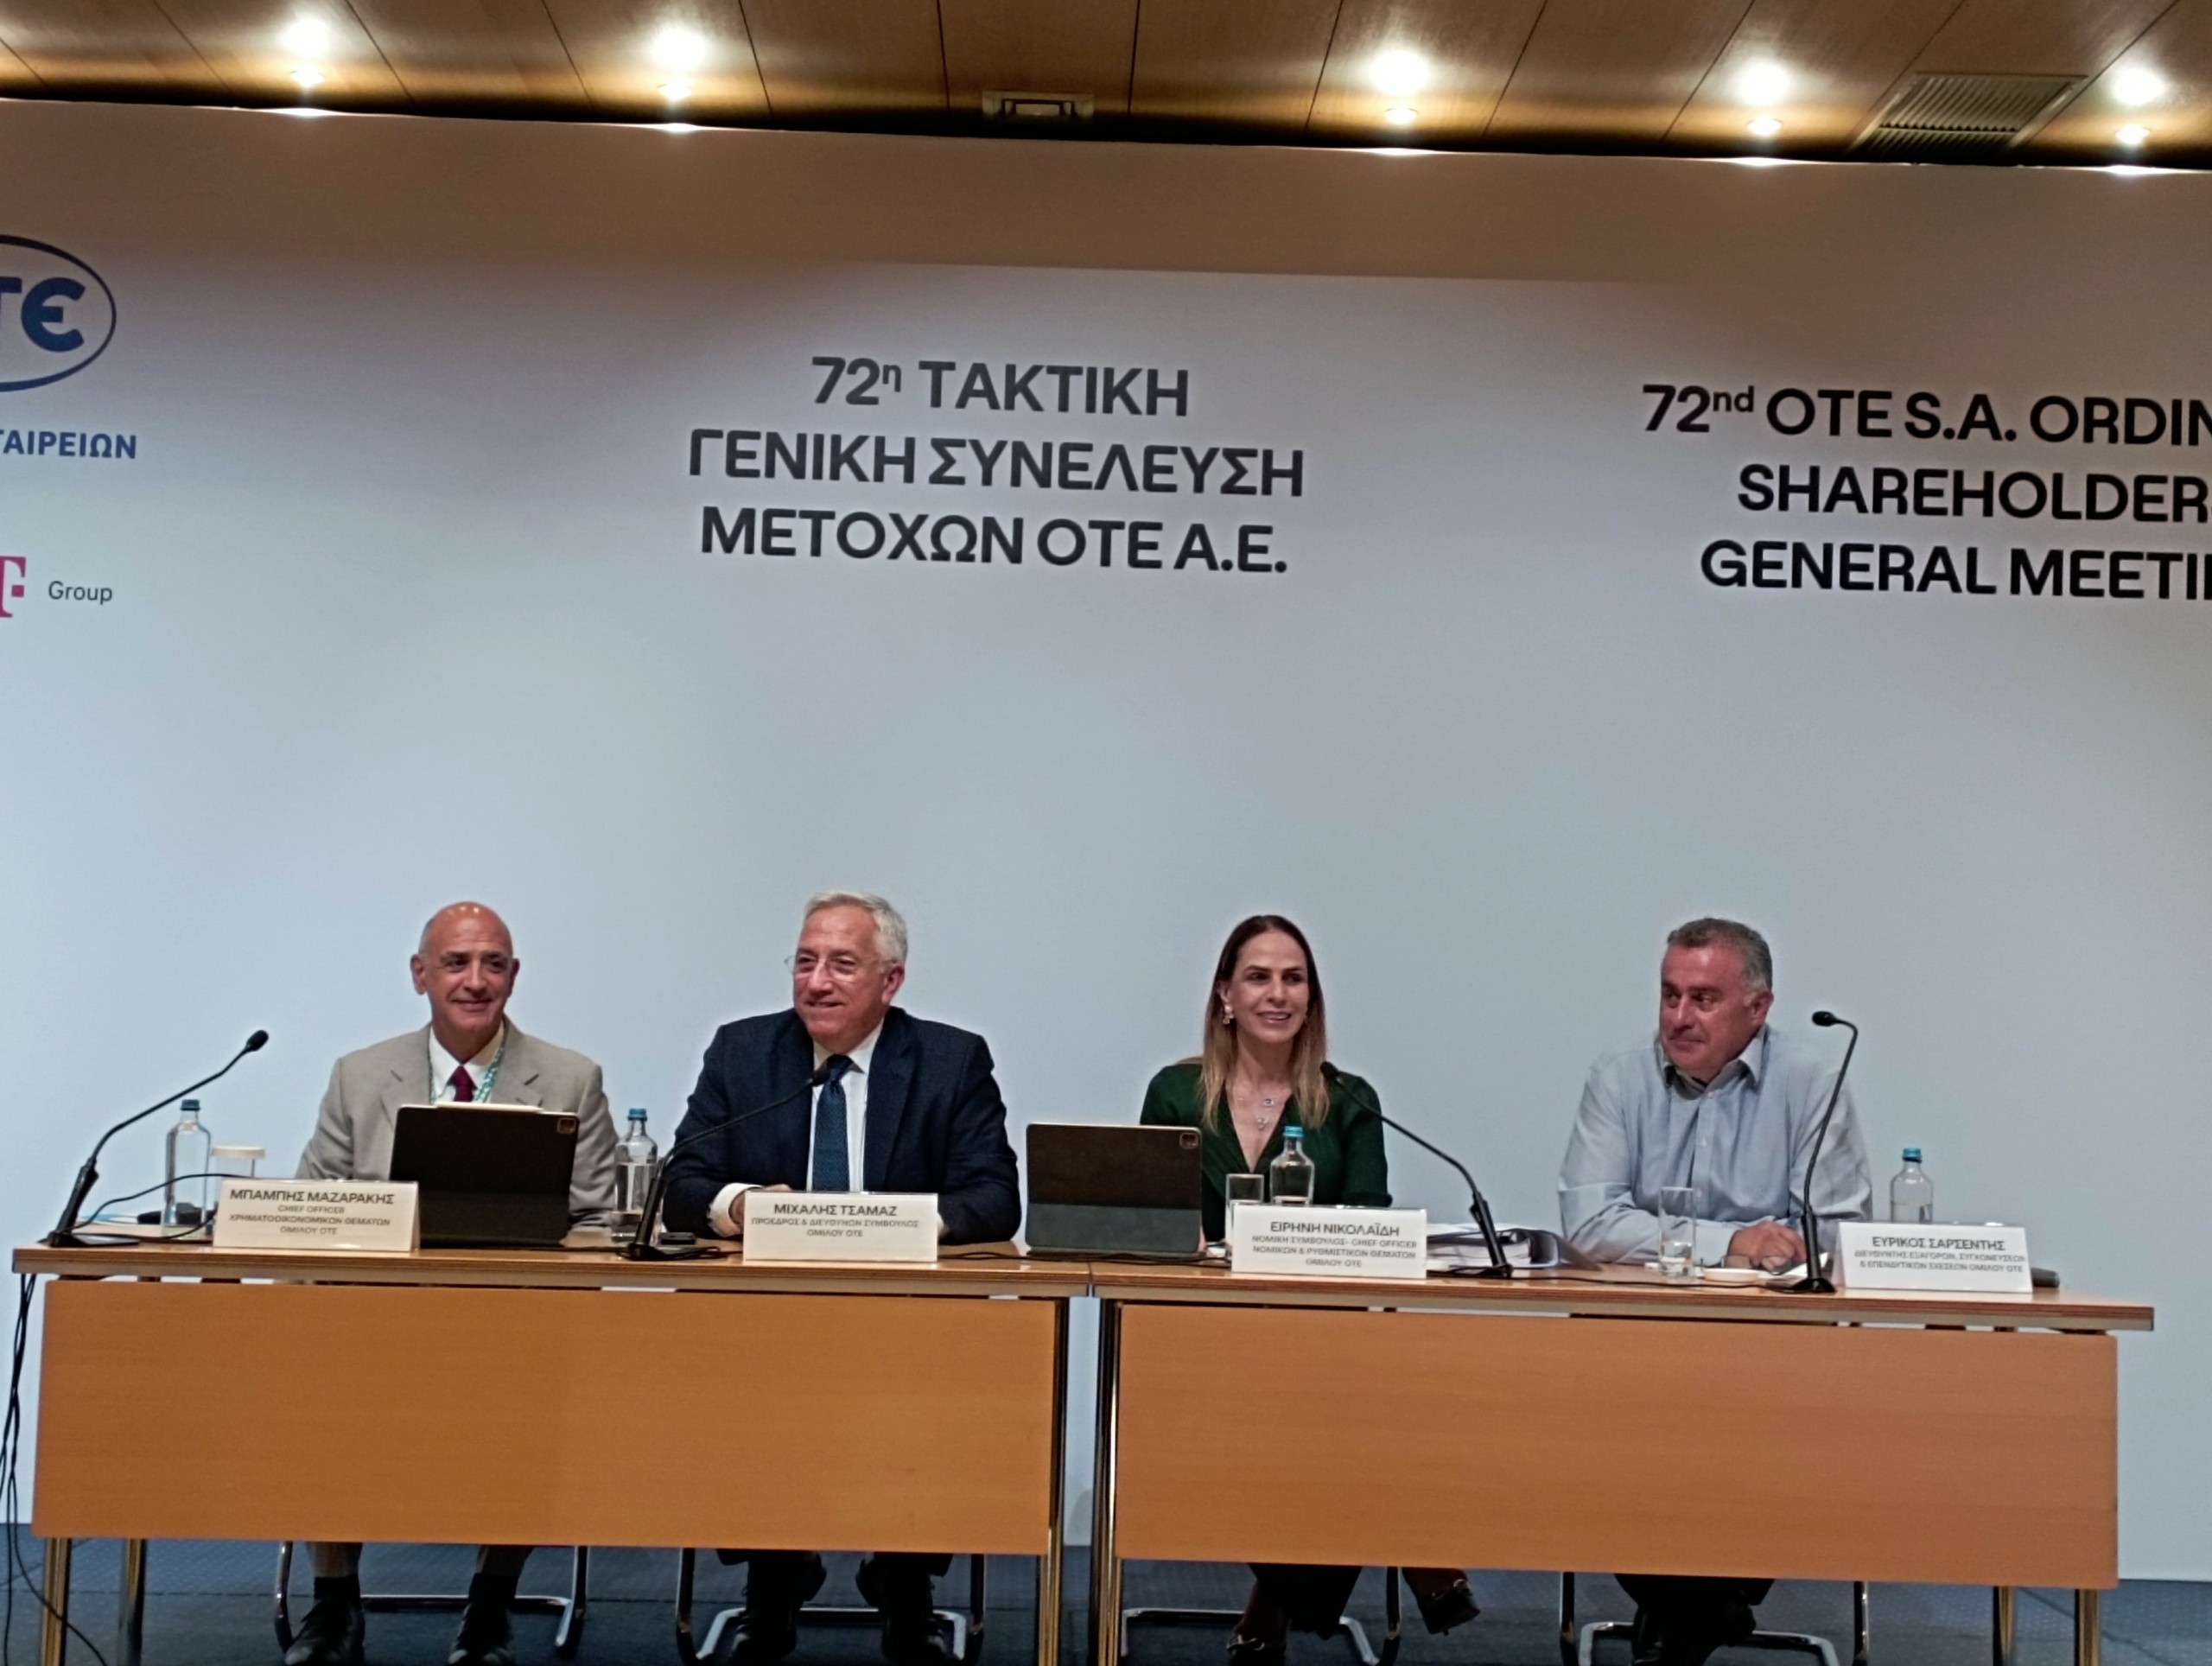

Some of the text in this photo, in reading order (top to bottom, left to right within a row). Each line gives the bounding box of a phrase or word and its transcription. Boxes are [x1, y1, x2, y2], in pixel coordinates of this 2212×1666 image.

[918, 359, 1189, 416] ΤΑΚΤΙΚΗ
[1643, 385, 1755, 433] 72nd
[1766, 388, 1892, 437] OTE
[1904, 392, 2017, 441] S.A.
[690, 429, 1304, 498] ΓΕΝΙΚΗ ΣΥΝΕΛΕΥΣΗ
[1738, 464, 2212, 523] SHAREHOLDER
[701, 506, 1287, 573] ΜΕΤΟΧΩΝ ΟΤΕ Α.Ε.
[48, 581, 113, 605] Group
[1700, 539, 2212, 601] GENERAL MEETI
[230, 1190, 395, 1204] ΜΠΑΜΠΗΣ ΜΑΖΑΡΑΚΗΣ
[773, 1204, 897, 1217] ΜΙΧΑΛΗΣ ΤΣΑΜΑΖ
[1324, 1223, 1400, 1237] ΝΙΚΟΛΑΪΔΗ
[1872, 1237, 2005, 1250] ΕΥΡΙΚΟΣ ΣΑΡΣΕΝΤΗΣ
